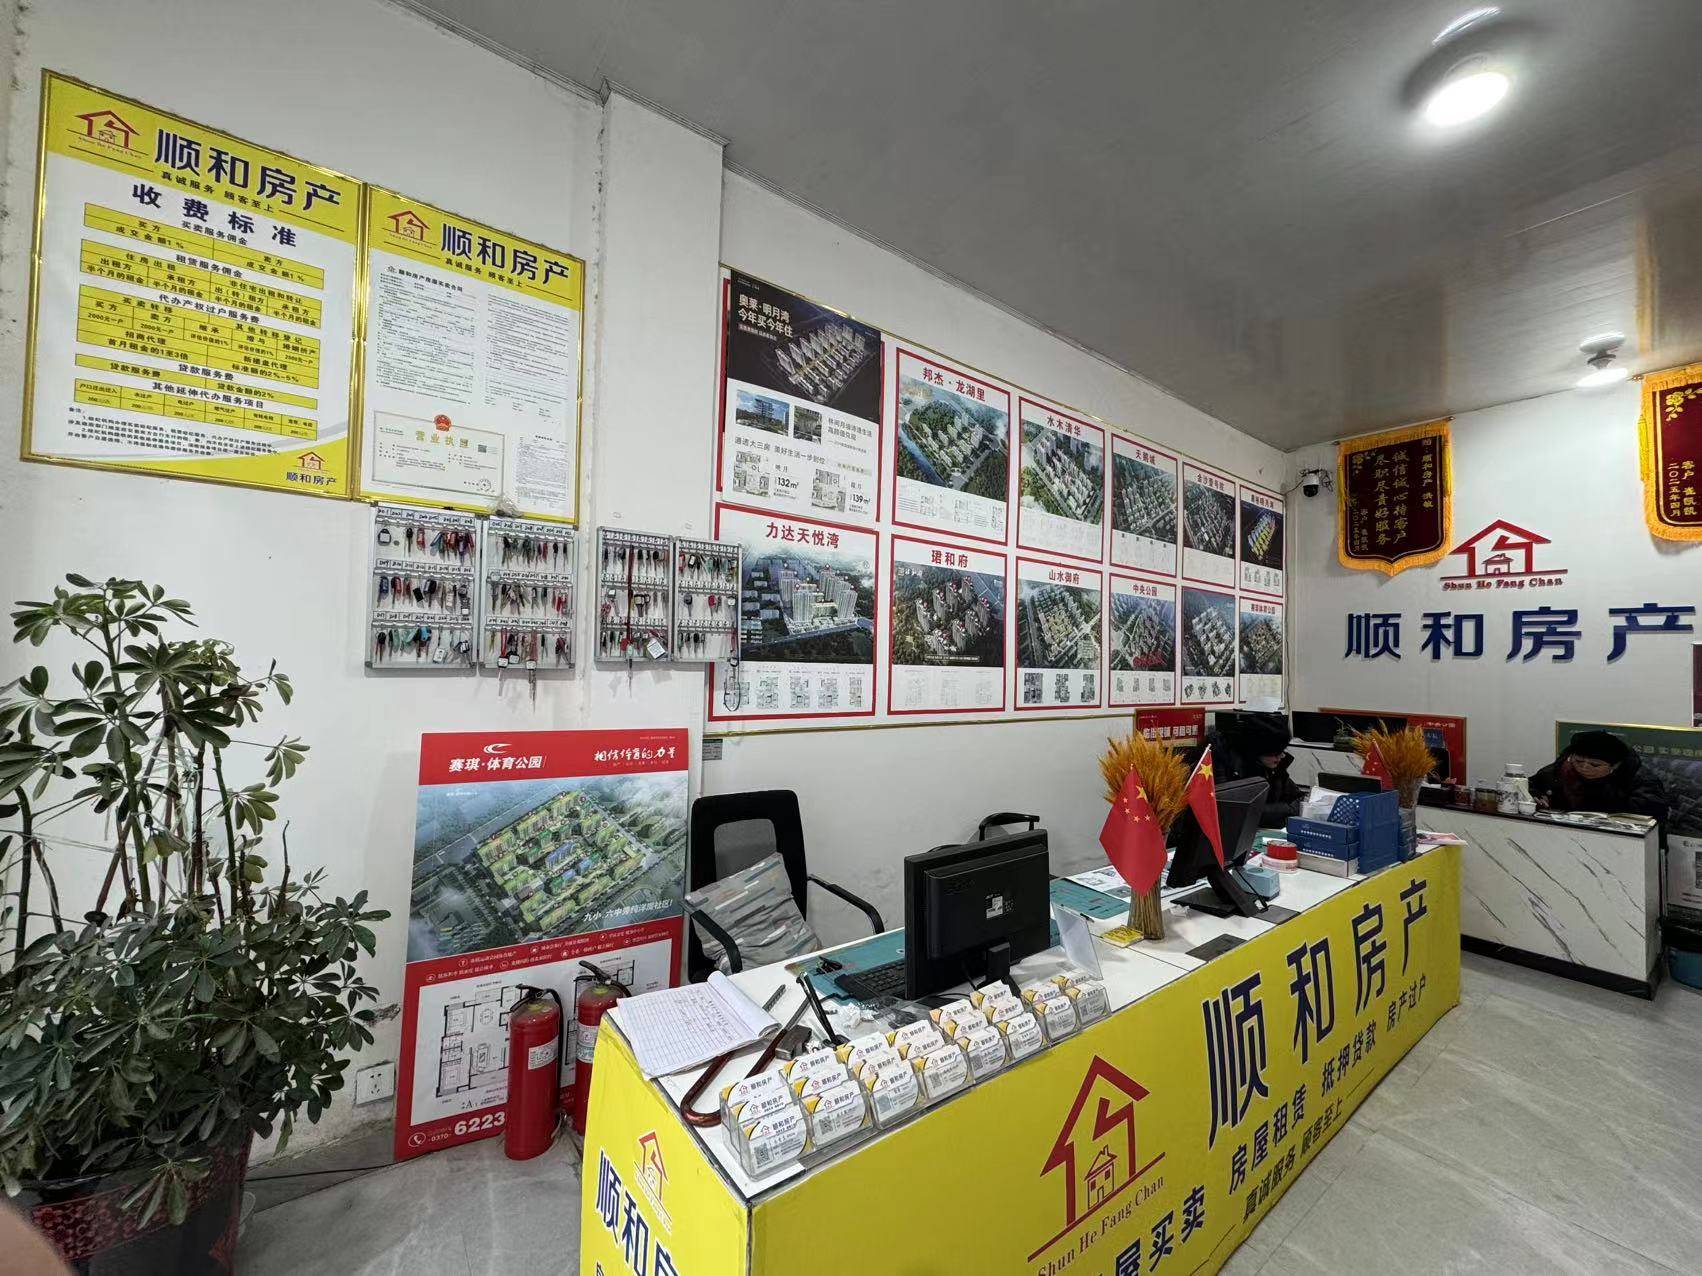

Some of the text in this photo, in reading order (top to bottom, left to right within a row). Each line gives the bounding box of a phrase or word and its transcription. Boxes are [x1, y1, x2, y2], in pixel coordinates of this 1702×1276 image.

[154, 128, 341, 211] 顺和房产
[161, 170, 274, 213] 真诚服务 顾客至上
[132, 184, 297, 248] 收费标准
[182, 220, 248, 246] 买卖服务佣金
[100, 257, 132, 271] 出租方
[176, 254, 243, 279] 租赁服务佣金
[441, 223, 570, 285] 顺和房产
[87, 264, 145, 285] 半个月的租金
[445, 257, 523, 288] 真诚服务 顾客至上
[95, 300, 117, 312] 买方
[159, 294, 260, 324] 代办产权过户服务费
[737, 309, 793, 339] 今年买今年住
[178, 362, 234, 381] 贷款服务费
[922, 366, 985, 403] 邦杰·龙湖里
[152, 382, 264, 409] 其他延伸代办服务项目
[1046, 414, 1081, 437] 水木清华
[283, 471, 336, 486] 顺和房产
[766, 521, 840, 549] 力达天悦湾
[931, 549, 968, 569] 珺和府
[1048, 569, 1080, 586] 山水御府
[1133, 584, 1158, 597] 中央公园
[1443, 577, 1563, 592] Shun He Fang Chan
[1345, 602, 1696, 663] 顺和房产
[449, 755, 544, 773] 赛琪·体育公园
[1202, 878, 1428, 1151] 顺和房产
[1230, 974, 1427, 1195] 房屋租赁 抵押贷款 房产过户
[454, 1111, 505, 1136] 6223
[1242, 1095, 1342, 1224] 真诚服务 顾客至上
[1079, 1230, 1098, 1254] He
[1100, 1200, 1133, 1237] Fang
[1134, 1175, 1164, 1207] Chan
[1100, 1184, 1205, 1276] 屋买卖
